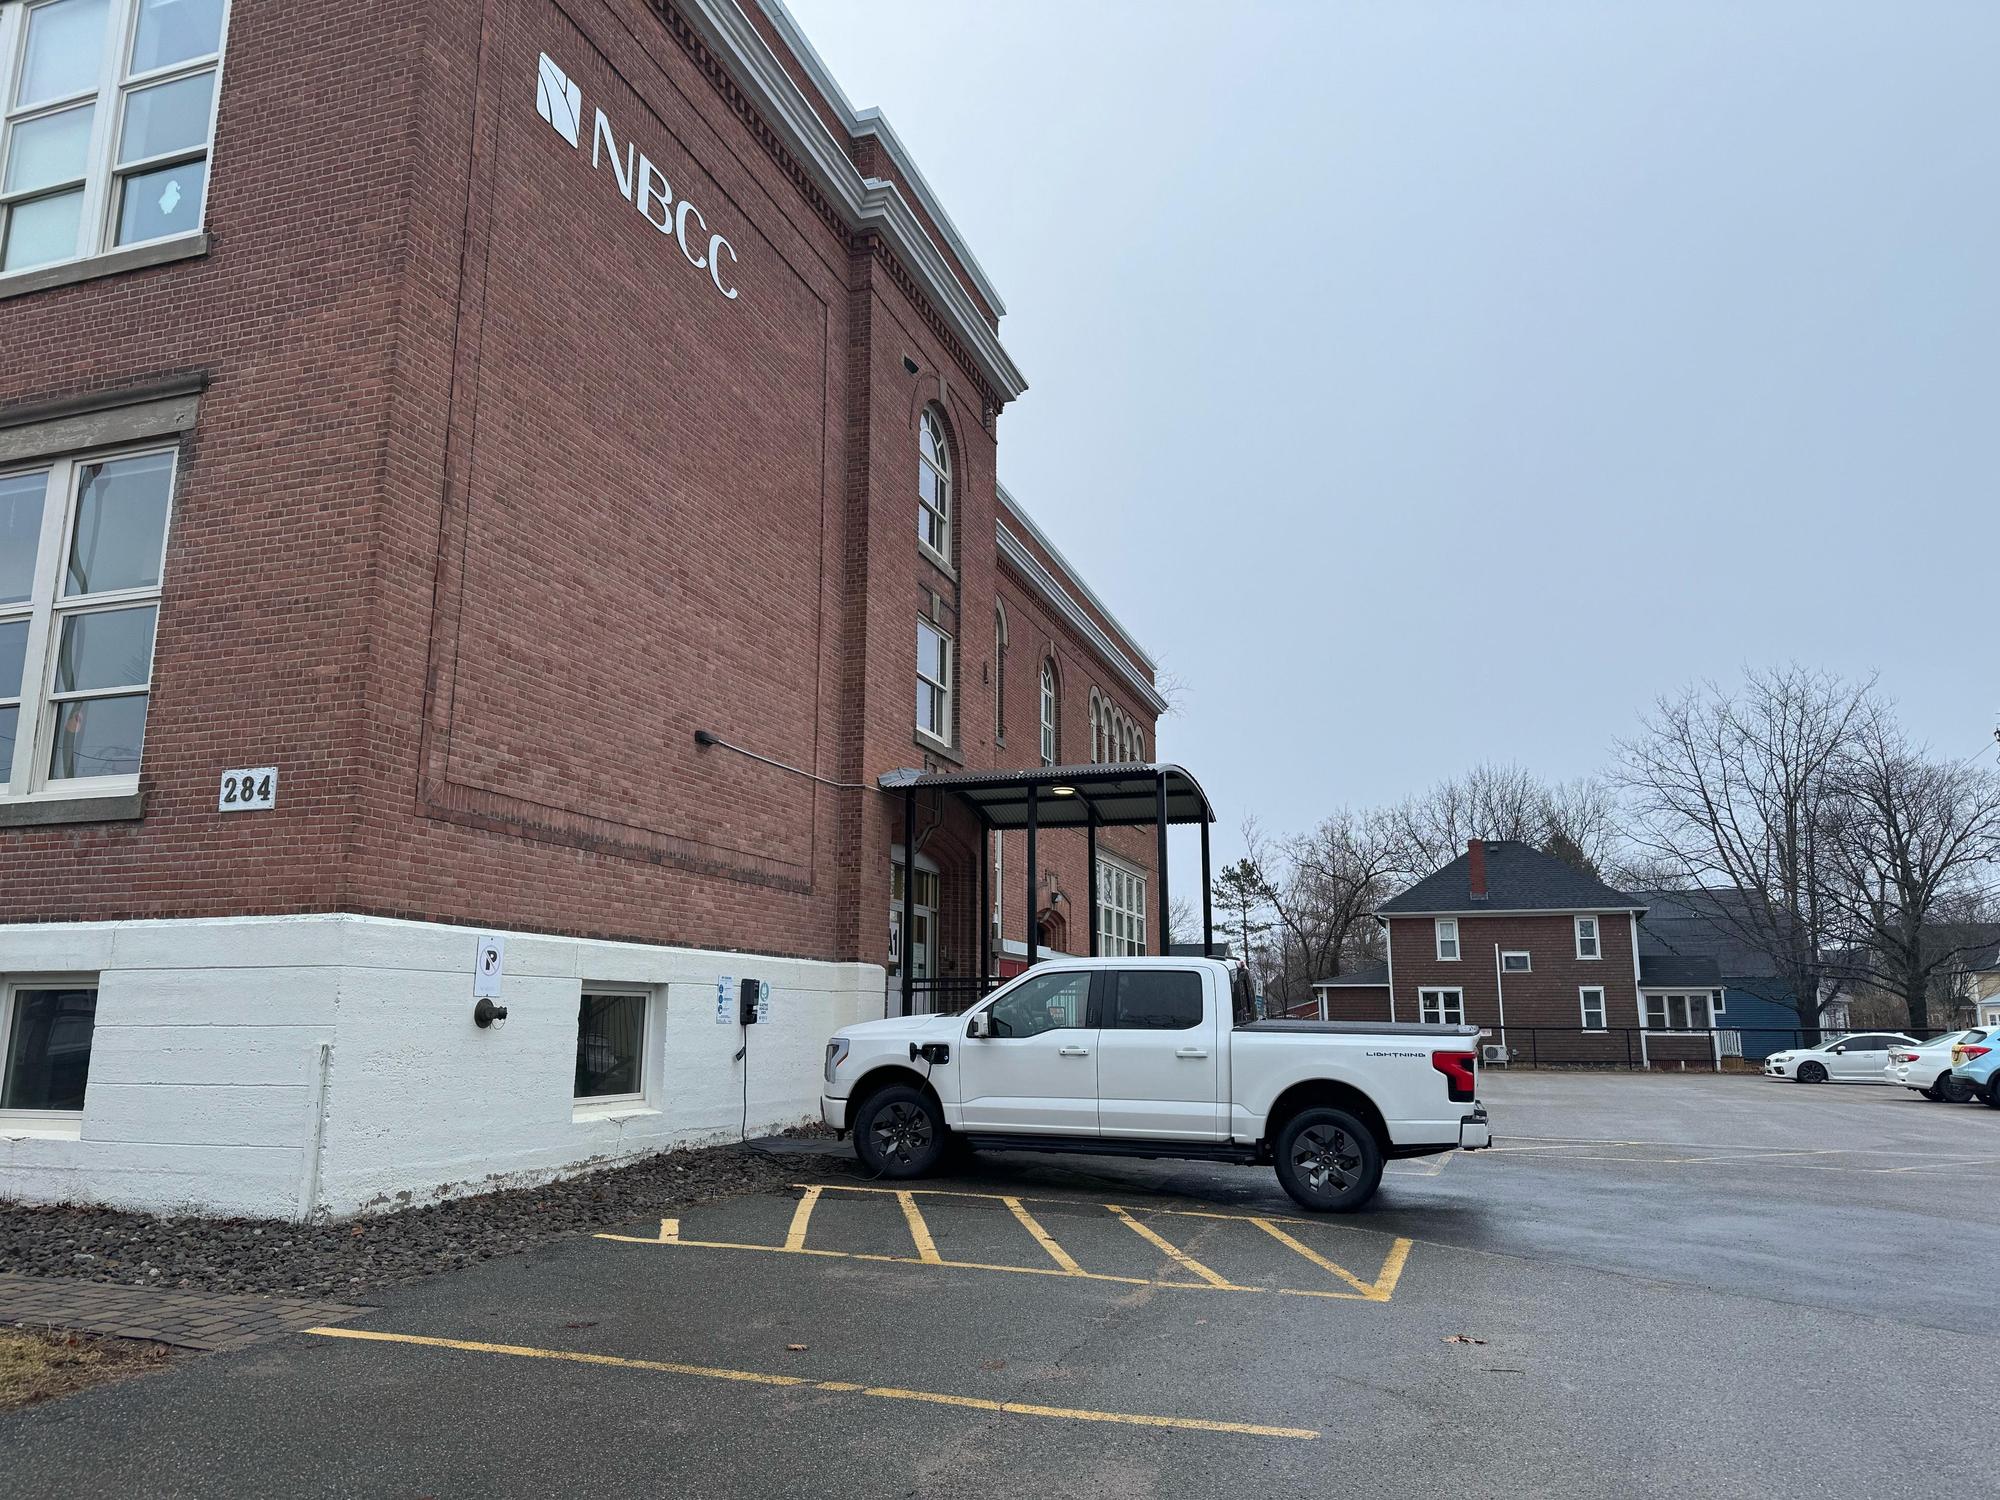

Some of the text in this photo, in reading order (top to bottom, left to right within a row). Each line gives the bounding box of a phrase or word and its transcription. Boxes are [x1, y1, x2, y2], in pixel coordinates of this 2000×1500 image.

[592, 106, 738, 300] NBCC
[223, 775, 271, 803] 284
[485, 950, 498, 971] P
